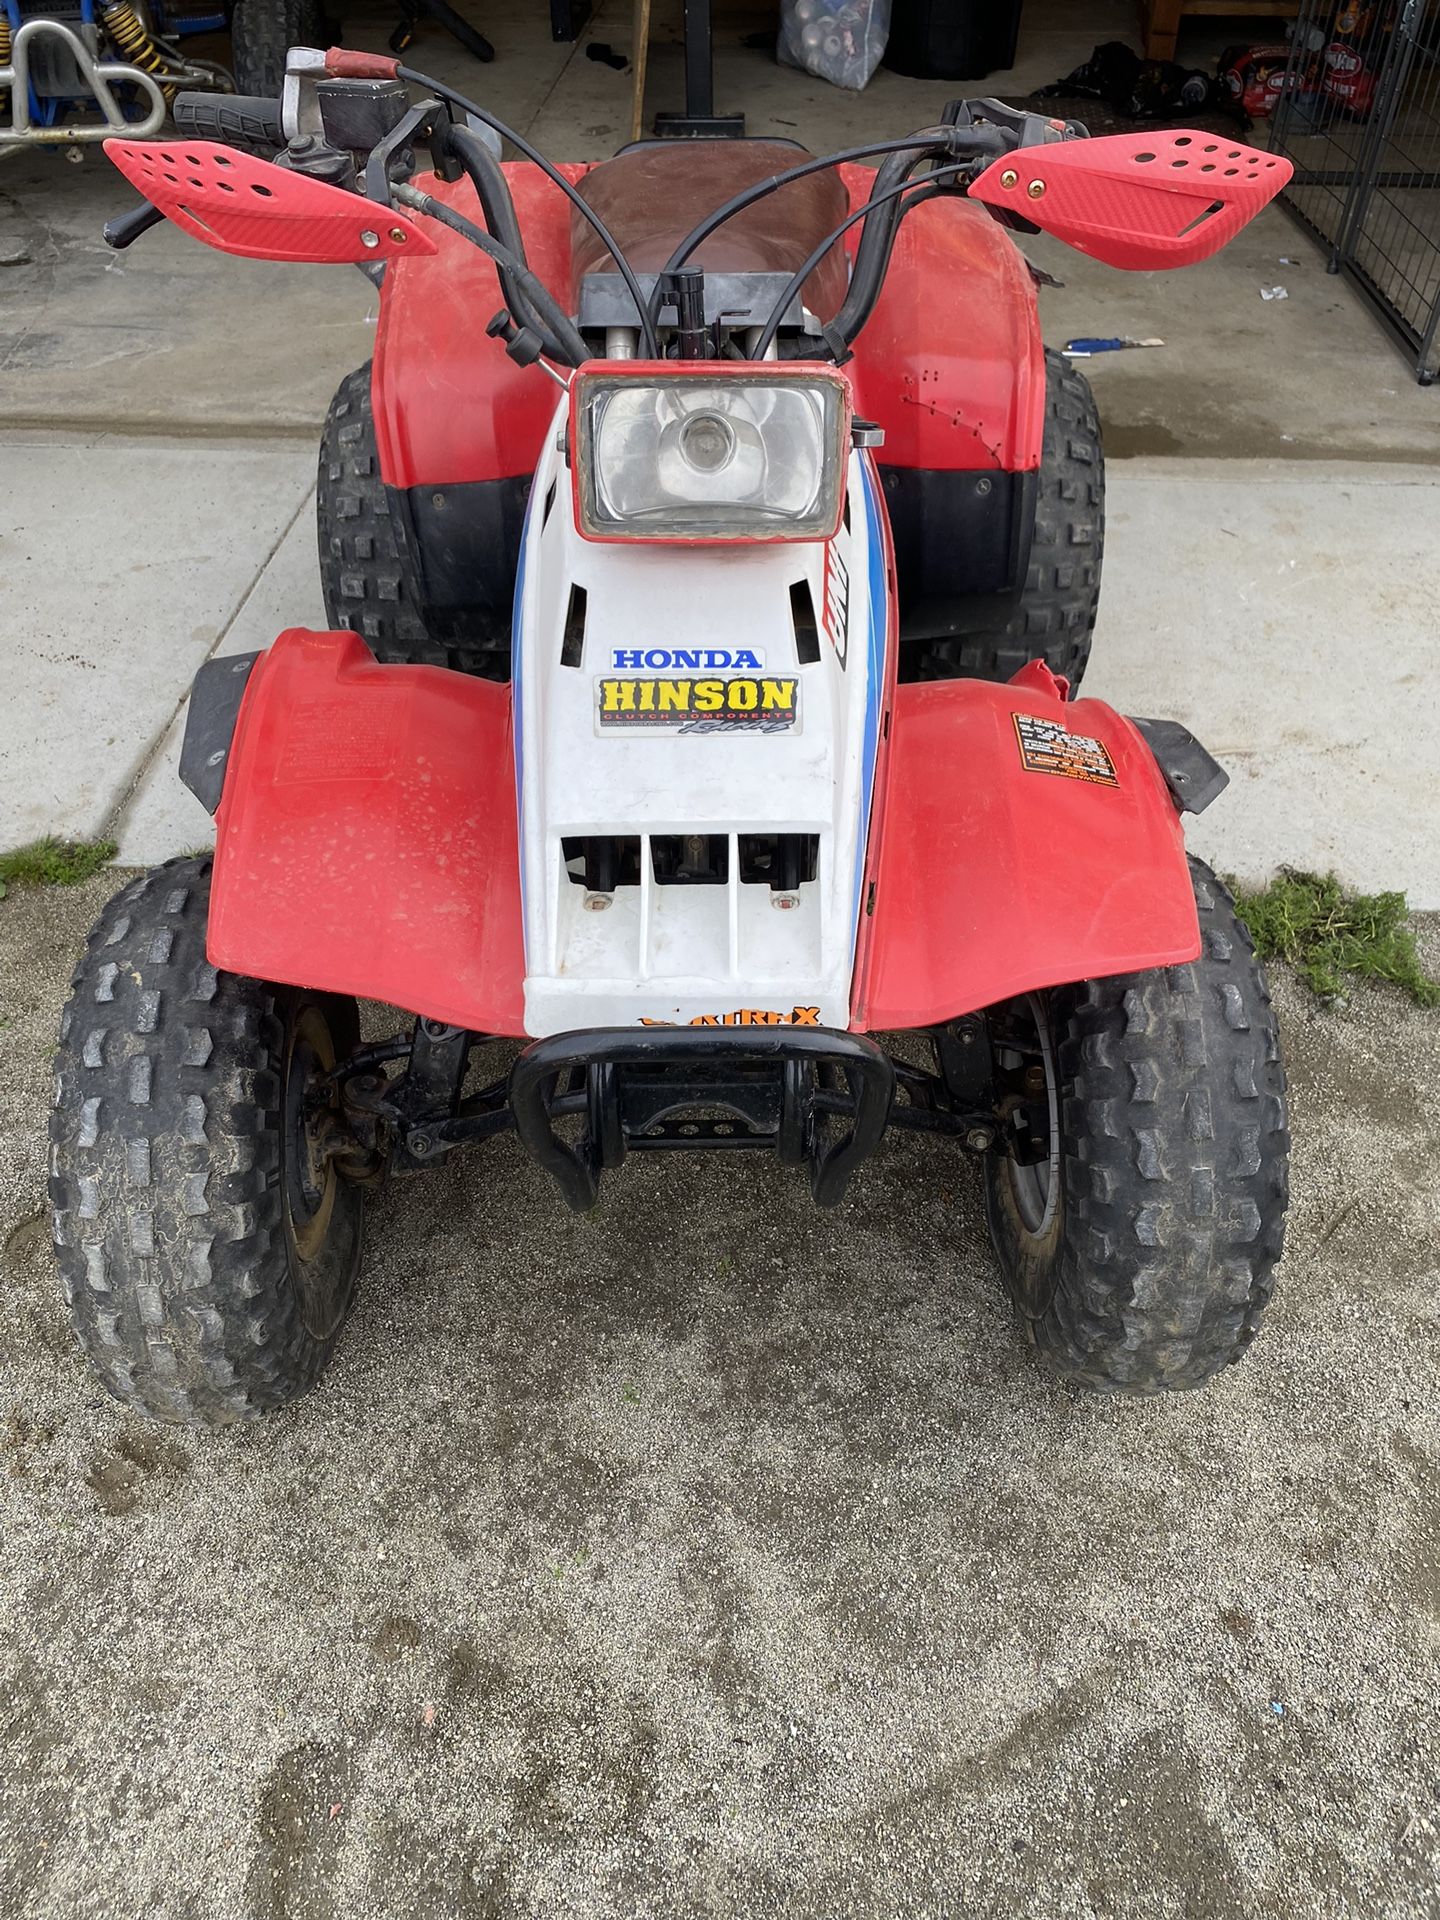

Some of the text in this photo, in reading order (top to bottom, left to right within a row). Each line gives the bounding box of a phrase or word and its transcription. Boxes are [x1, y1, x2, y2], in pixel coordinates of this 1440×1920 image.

[613, 649, 763, 669] HONDA
[602, 680, 795, 711] HINSON
[603, 711, 793, 720] CLUTCH COMPONENTS
